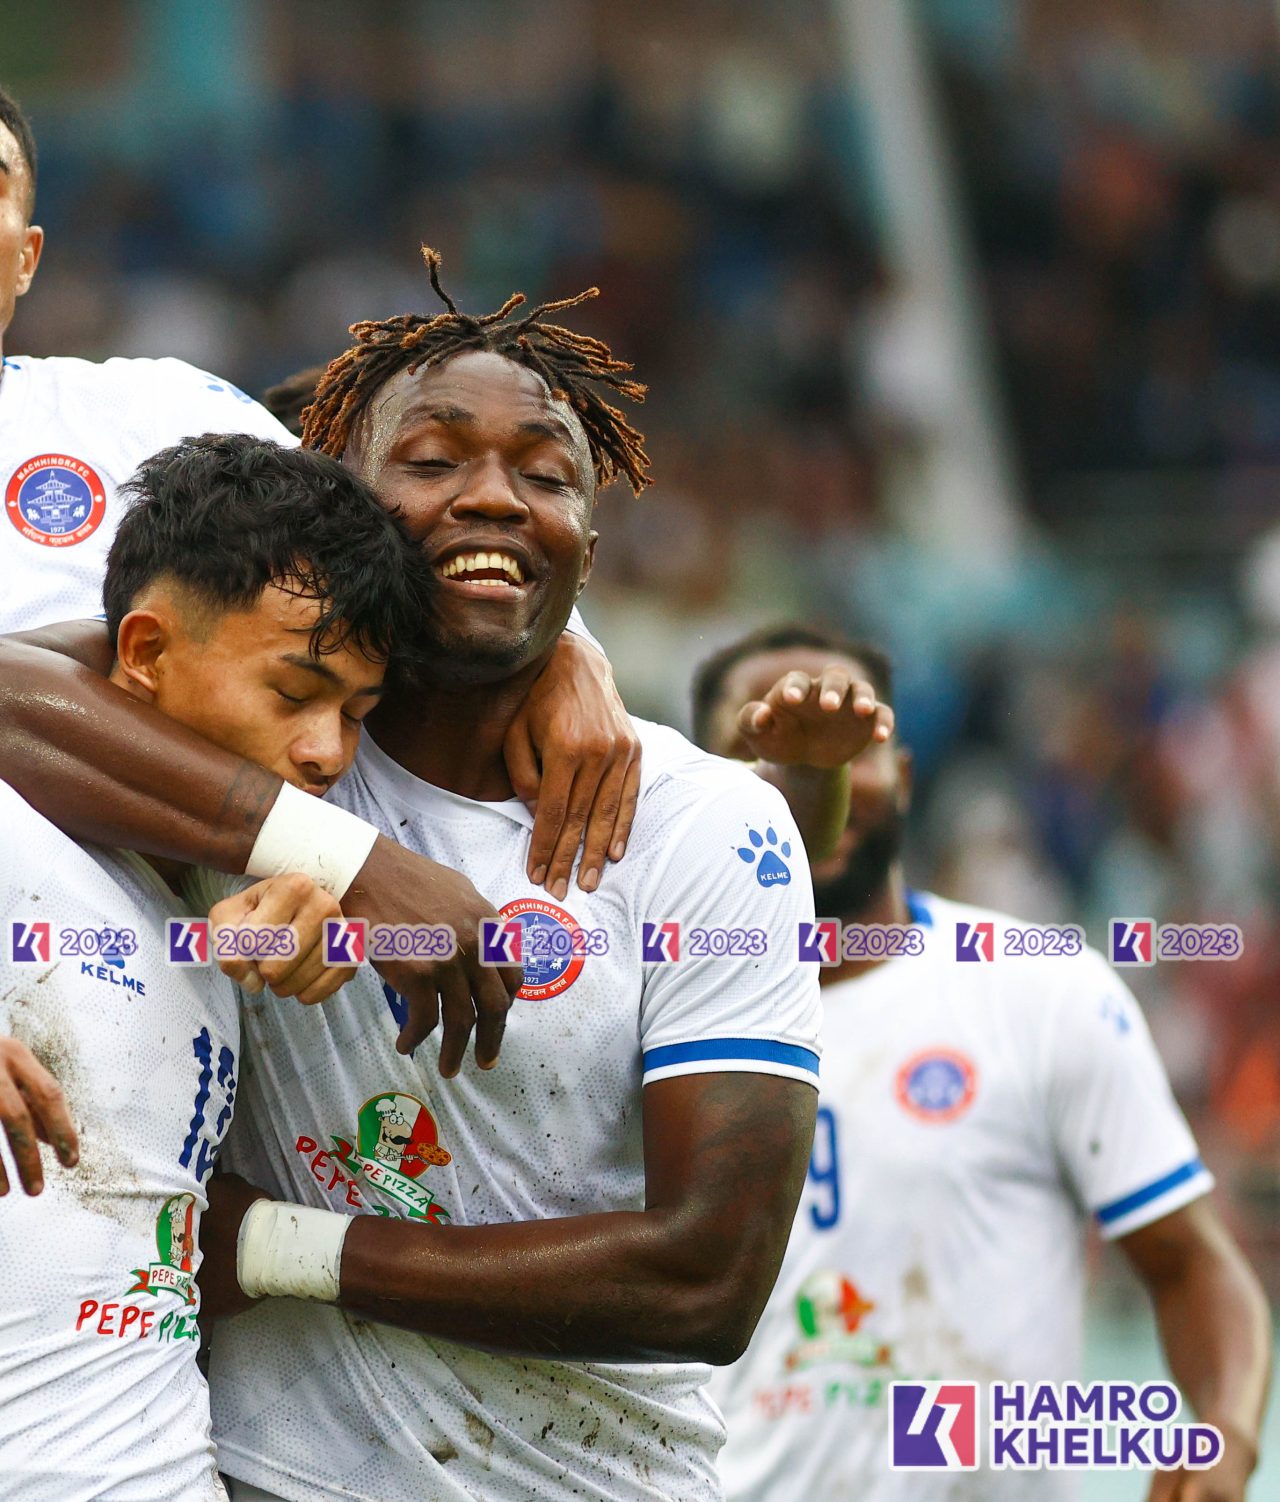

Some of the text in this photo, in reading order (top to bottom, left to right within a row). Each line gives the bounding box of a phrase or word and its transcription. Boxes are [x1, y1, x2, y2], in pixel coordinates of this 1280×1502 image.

[16, 457, 90, 480] MACHHINDRA FC
[760, 871, 789, 882] KELME
[500, 902, 574, 929] MACHHINDRA FC
[81, 961, 146, 996] KELME
[523, 976, 539, 984] 1973
[383, 1174, 429, 1208] PIZZA
[151, 1269, 175, 1285] PEPE
[76, 1300, 154, 1339] PEPE
